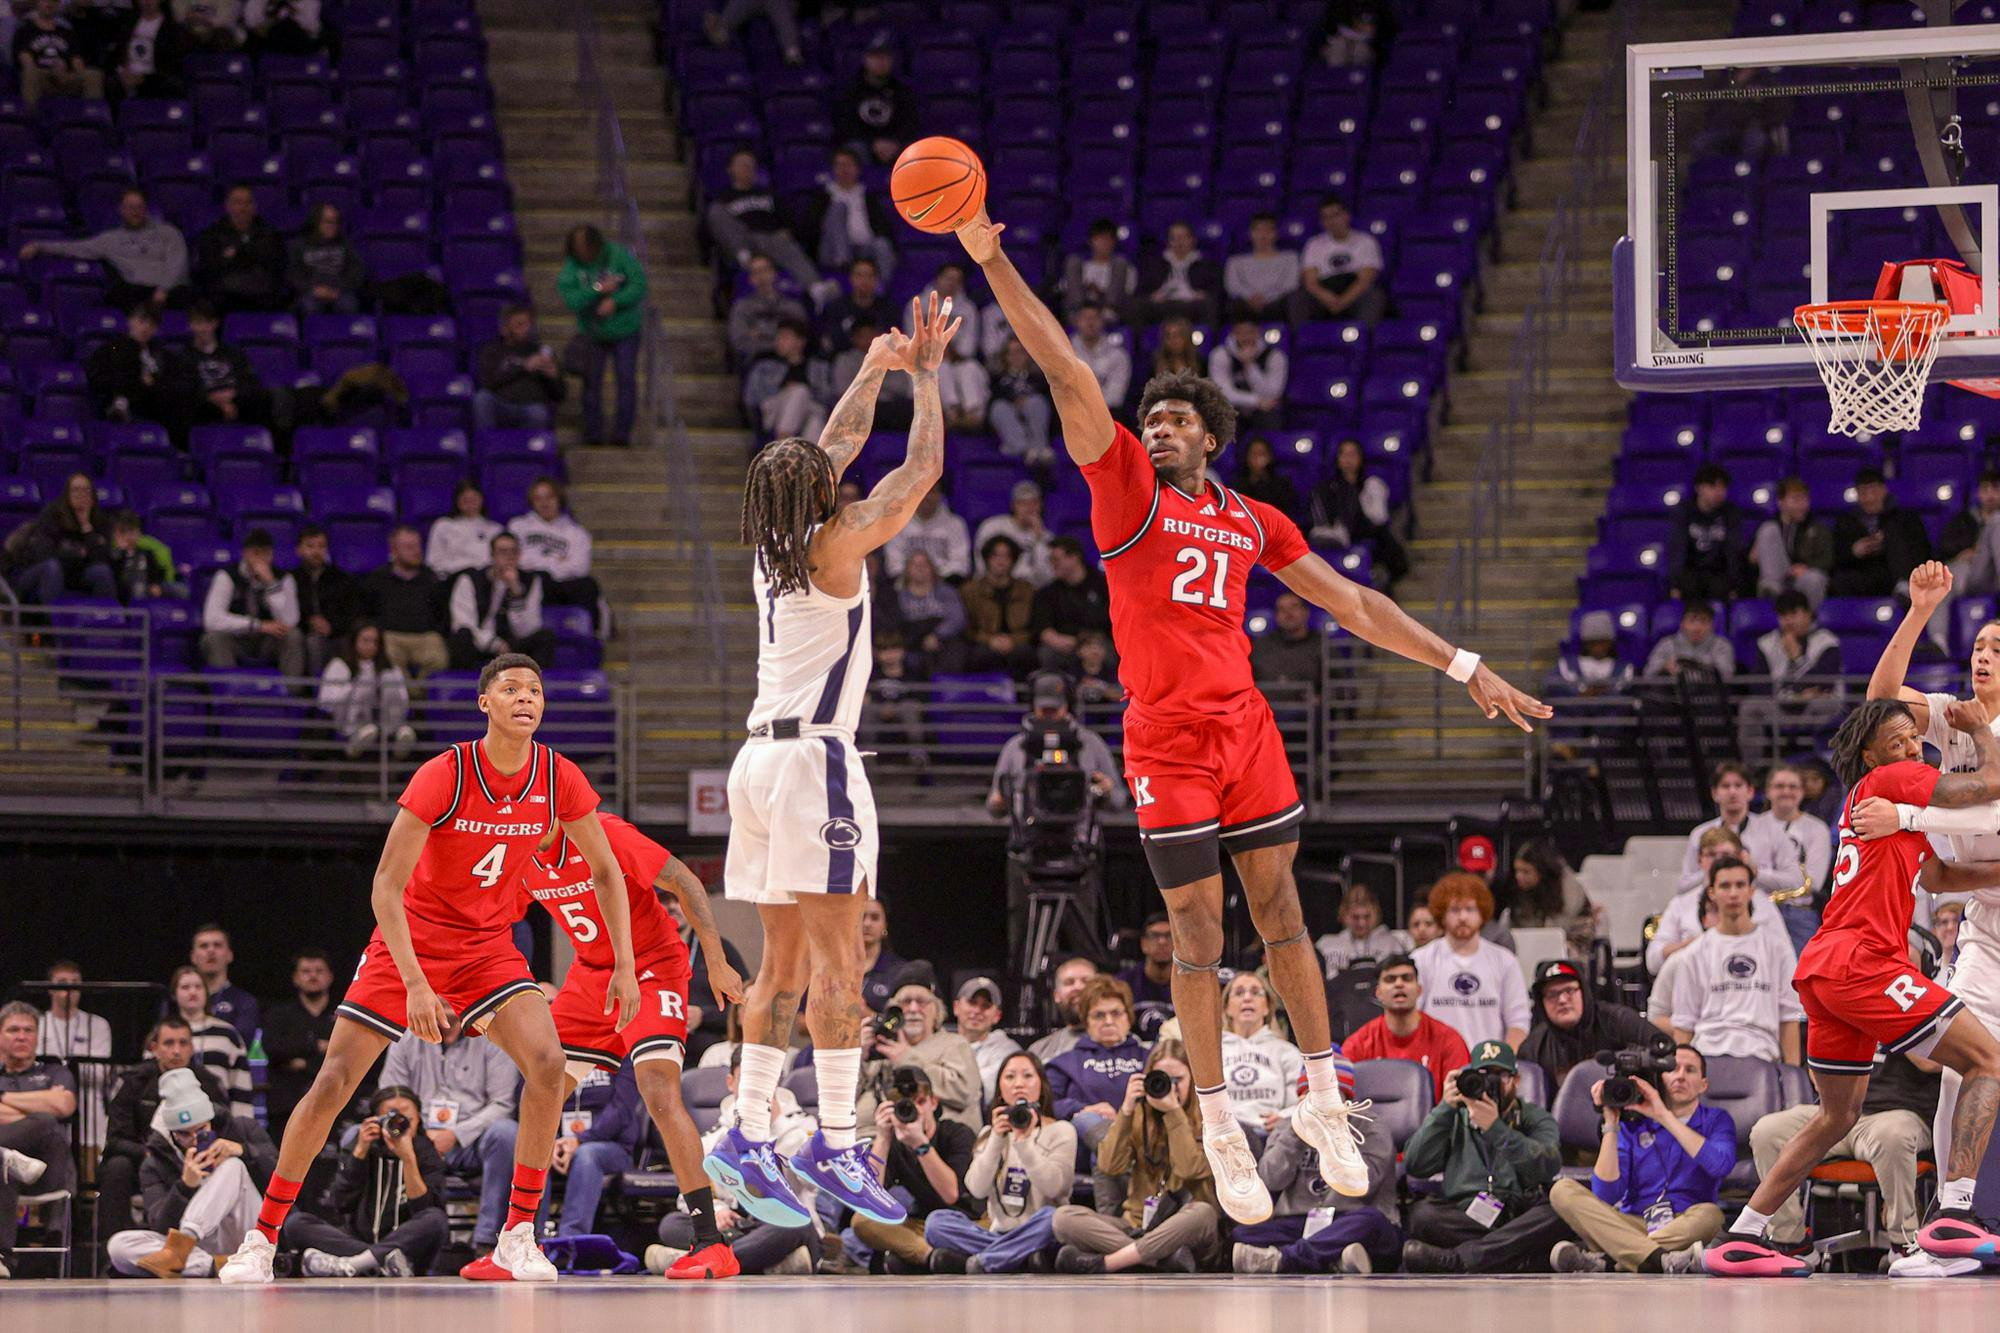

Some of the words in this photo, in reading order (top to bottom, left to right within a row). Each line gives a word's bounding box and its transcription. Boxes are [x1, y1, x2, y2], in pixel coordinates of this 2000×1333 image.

[1652, 352, 1704, 367] SPALDING
[1162, 517, 1254, 551] RUTGERS
[1171, 547, 1229, 609] 21
[454, 818, 543, 836] RUTGERS
[471, 841, 509, 889] 4
[531, 878, 596, 901] RUTGERS
[558, 901, 599, 943] 5
[657, 989, 685, 1021] R
[1882, 974, 1929, 1013] R
